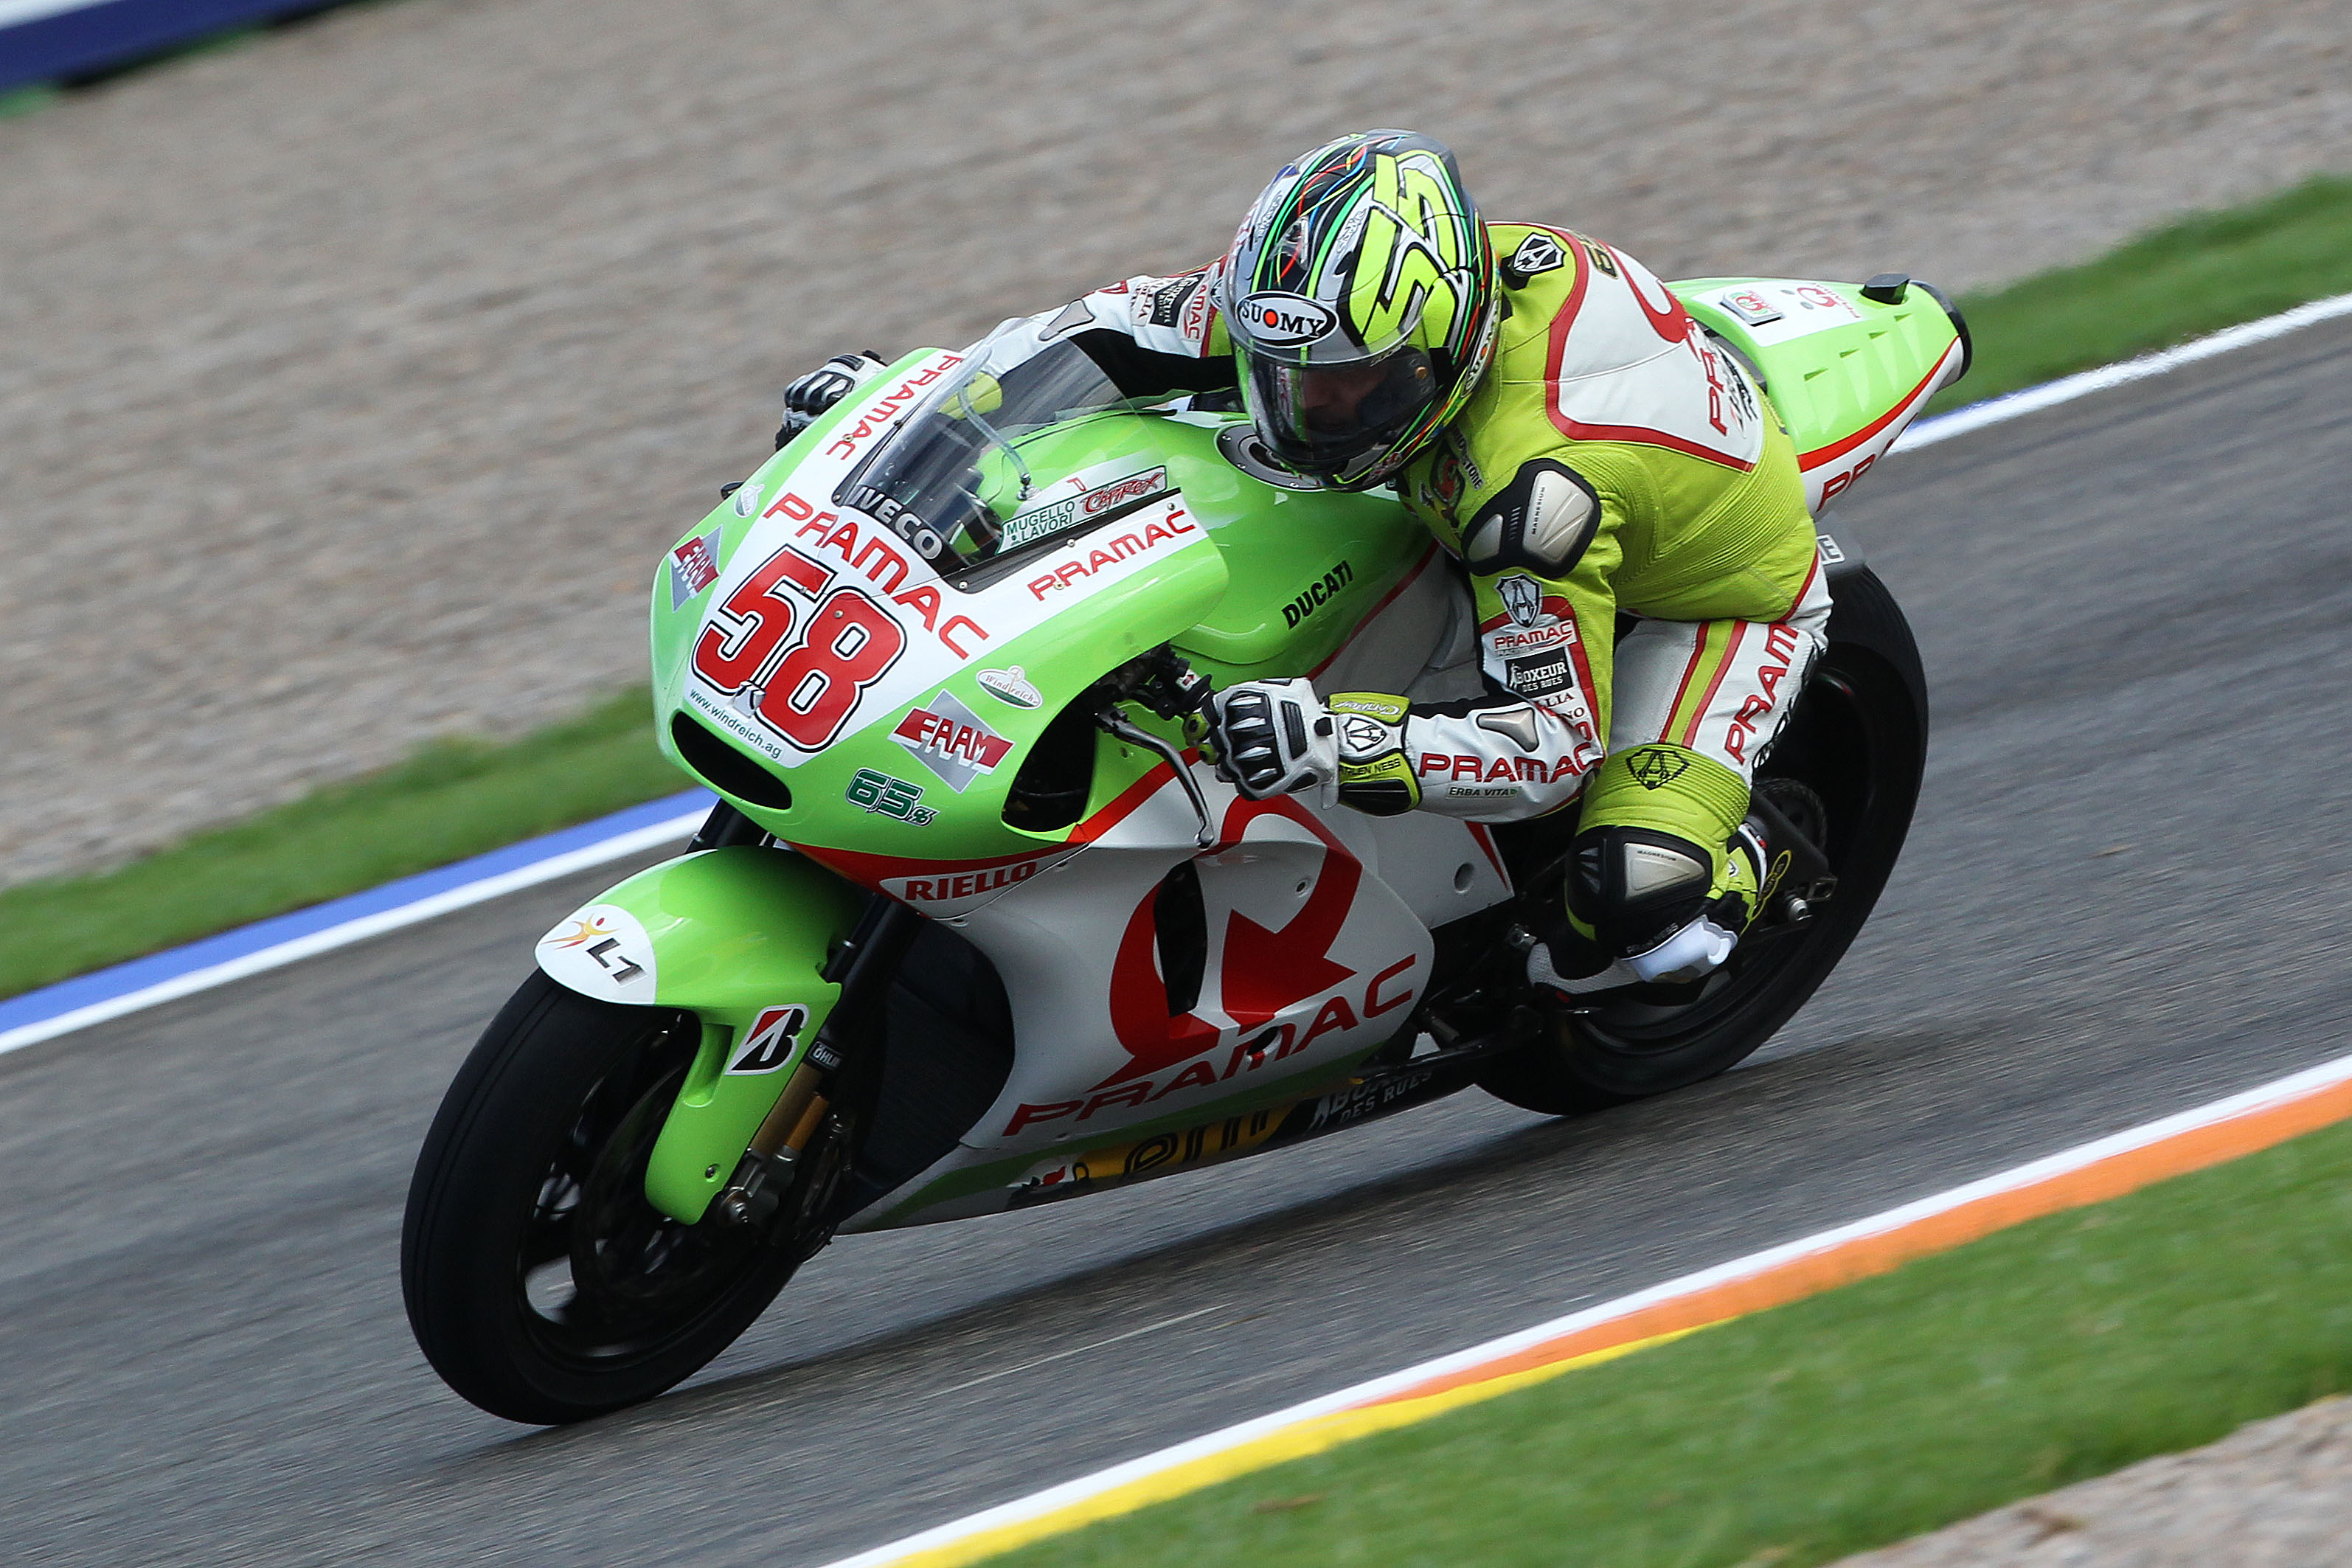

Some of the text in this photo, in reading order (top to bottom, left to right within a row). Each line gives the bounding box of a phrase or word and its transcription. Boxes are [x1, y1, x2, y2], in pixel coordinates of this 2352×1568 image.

[1240, 302, 1325, 336] SUOMY
[826, 354, 963, 461] PRAMAC
[851, 486, 943, 560] IVECO
[1006, 500, 1075, 535] MUGELLO
[1021, 513, 1074, 541] LAVORI
[1531, 487, 1546, 535] MAGNESIUM
[763, 492, 990, 660] PRAMAC
[1027, 510, 1196, 602] PRAMAC
[1281, 559, 1354, 630] DUCATI
[692, 544, 908, 753] 58
[1494, 622, 1572, 649] PRAMAC
[985, 674, 1034, 702] Windreich
[1516, 662, 1568, 684] BOXEUR
[1522, 676, 1564, 693] DES RUES
[1725, 622, 1800, 764] PRAM
[689, 687, 782, 758] www.windreich.ag
[909, 712, 994, 768] FAAM
[1374, 758, 1401, 772] NESS
[1418, 742, 1593, 785] PRAMAC
[1449, 786, 1510, 797] ERBA VITA
[905, 861, 1038, 901] RIELLO
[1002, 953, 1416, 1137] PRAMAC
